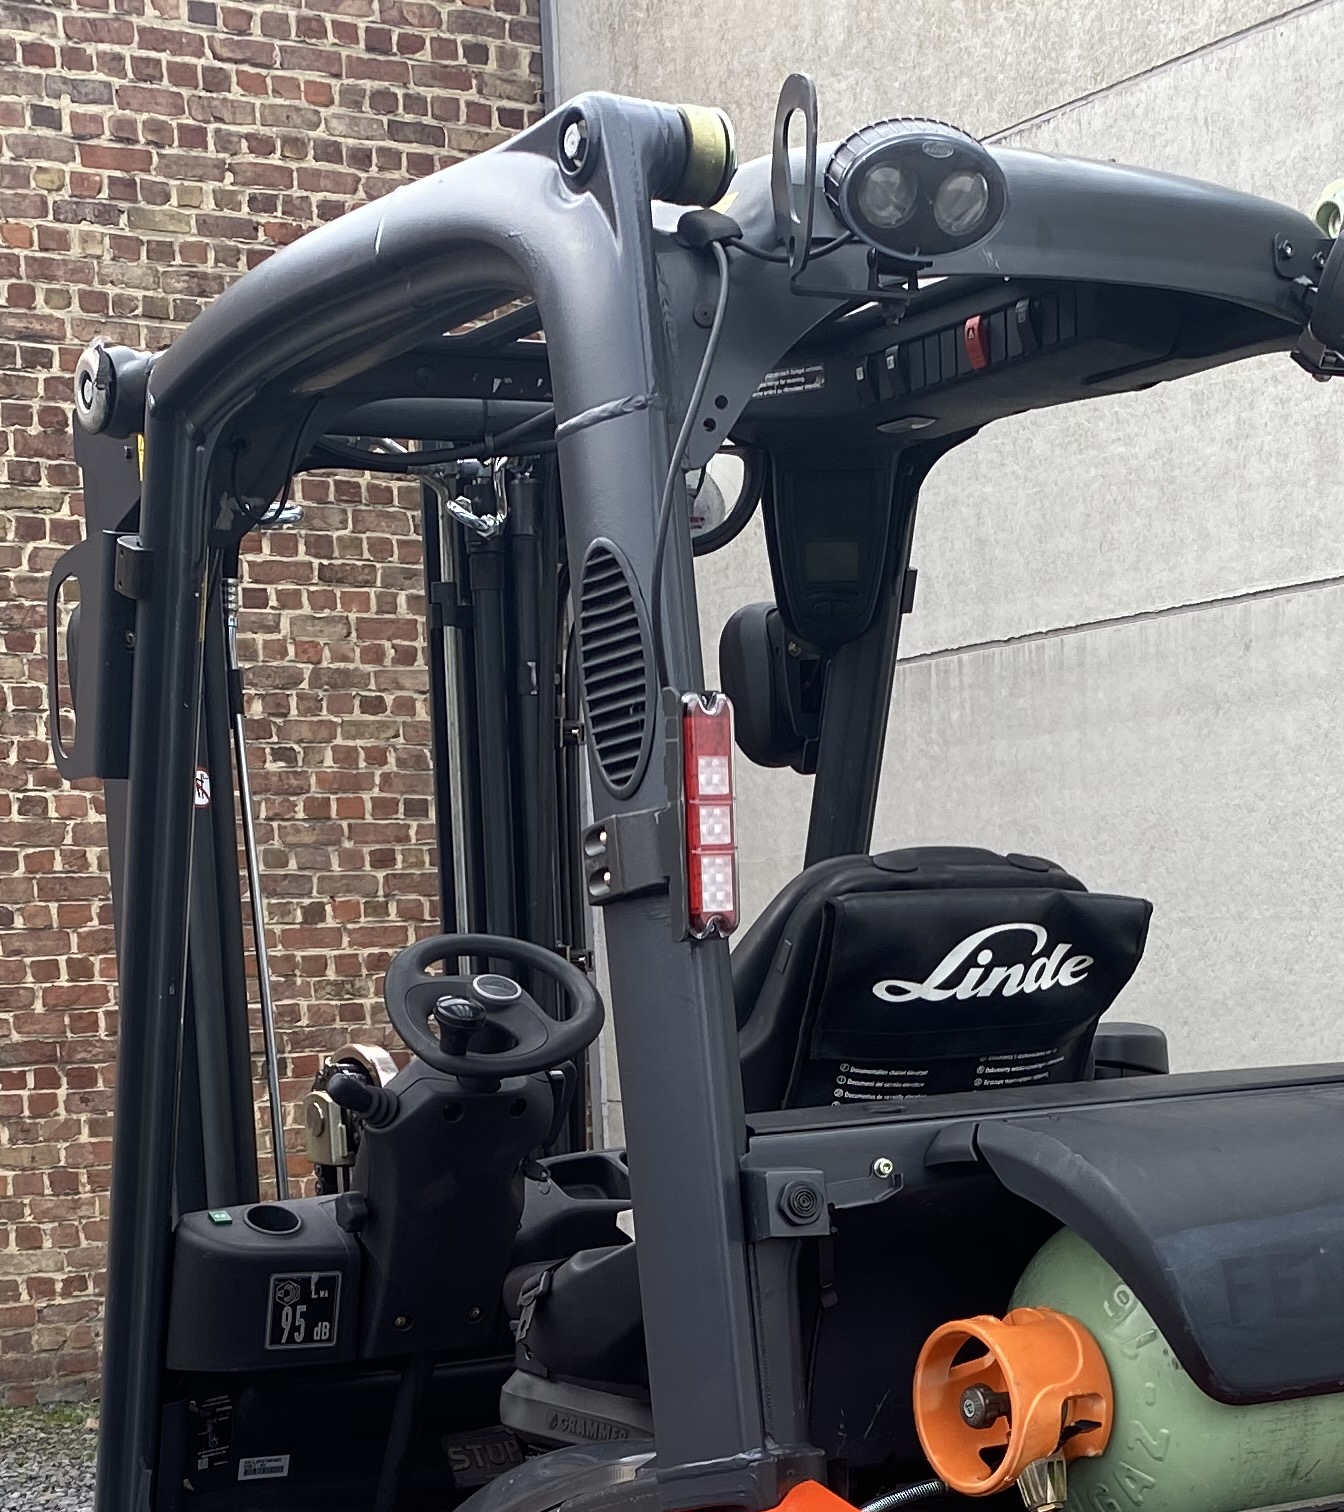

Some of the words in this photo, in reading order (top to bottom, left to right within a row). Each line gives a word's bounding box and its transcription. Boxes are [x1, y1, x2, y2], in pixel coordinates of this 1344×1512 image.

[872, 922, 1096, 1003] Linde
[281, 1305, 307, 1344] 95
[313, 1321, 331, 1341] dB
[447, 1440, 519, 1472] STOP
